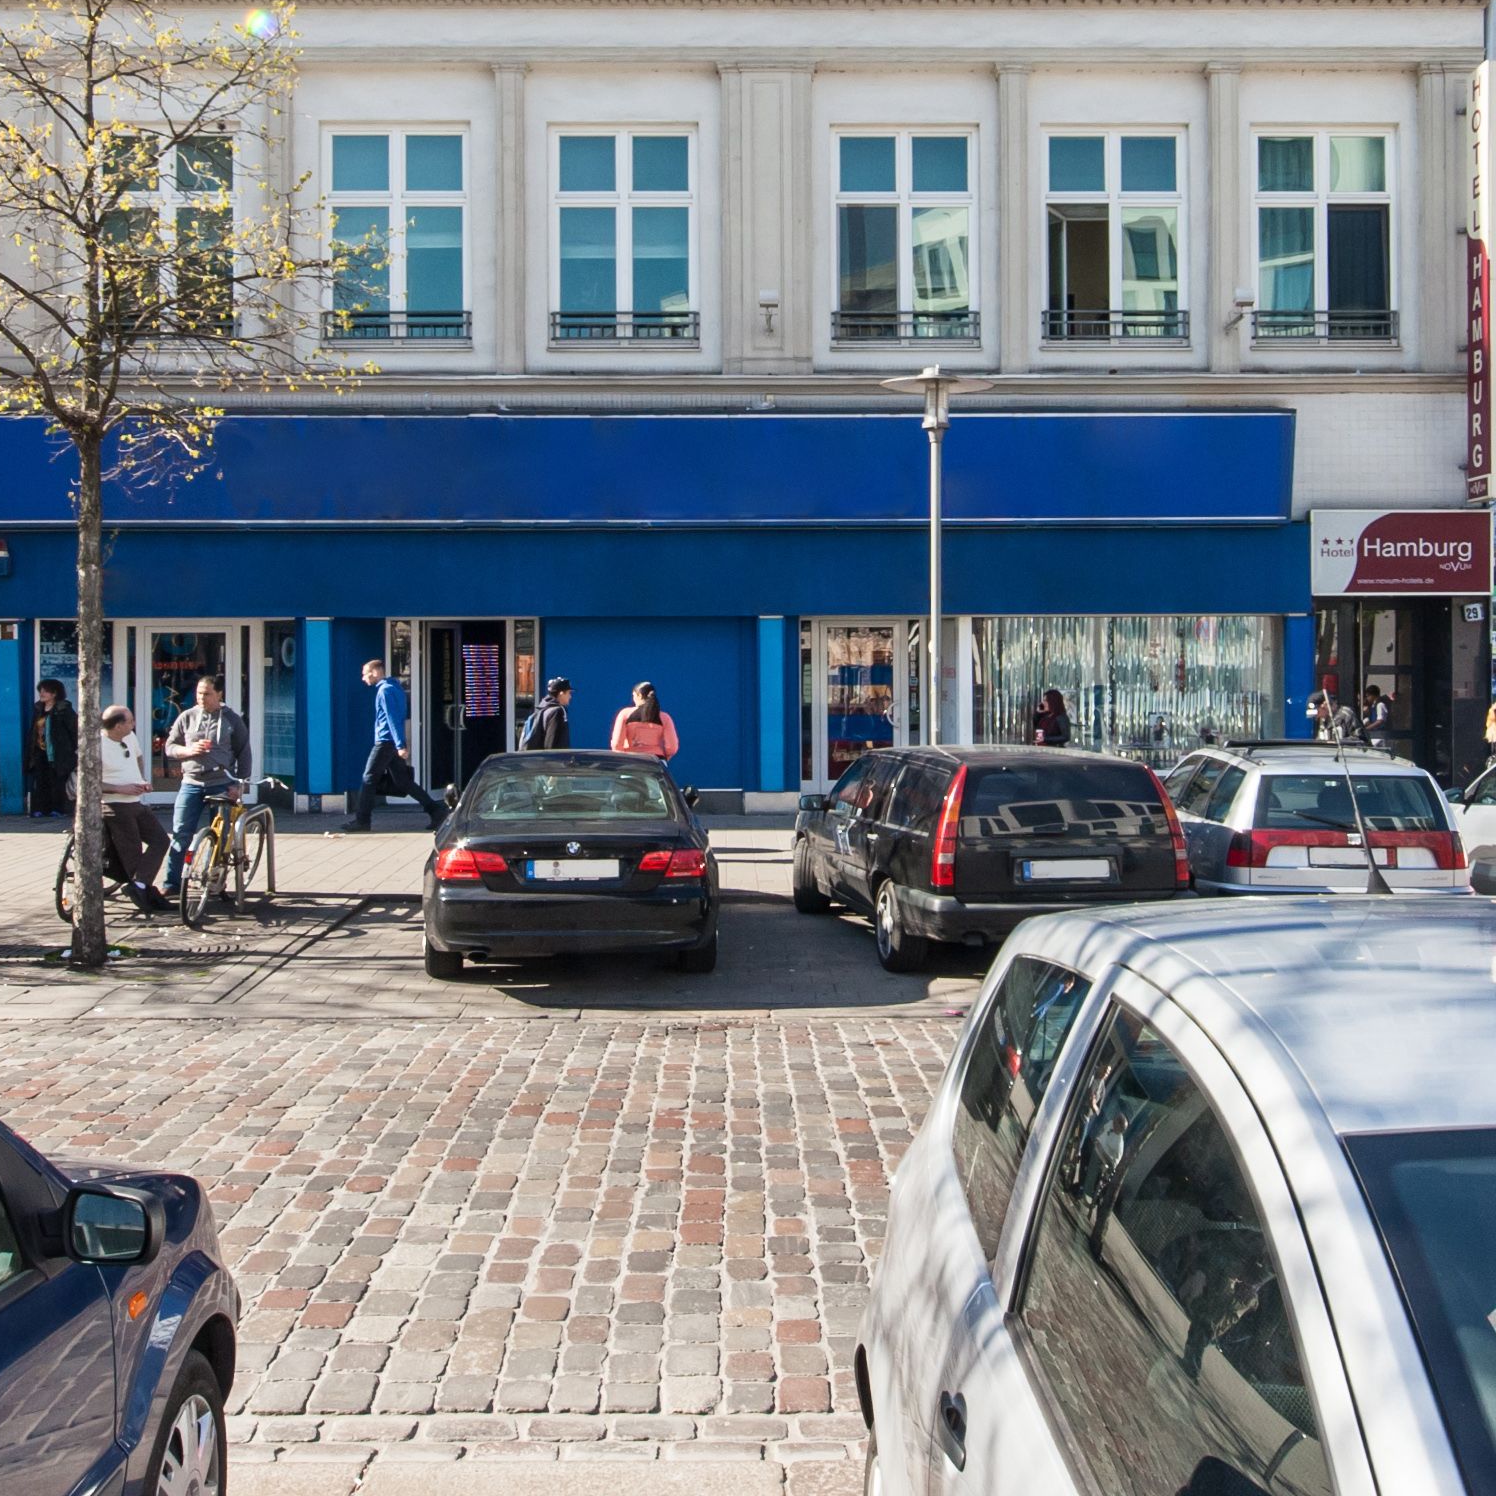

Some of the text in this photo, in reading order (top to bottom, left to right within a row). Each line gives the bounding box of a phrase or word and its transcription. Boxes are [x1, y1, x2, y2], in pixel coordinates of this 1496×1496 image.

[1471, 79, 1482, 233] HOTEL
[1471, 253, 1484, 469] HAMBURG
[1320, 537, 1473, 562] Hotel Hamburg
[1465, 606, 1479, 619] 29
